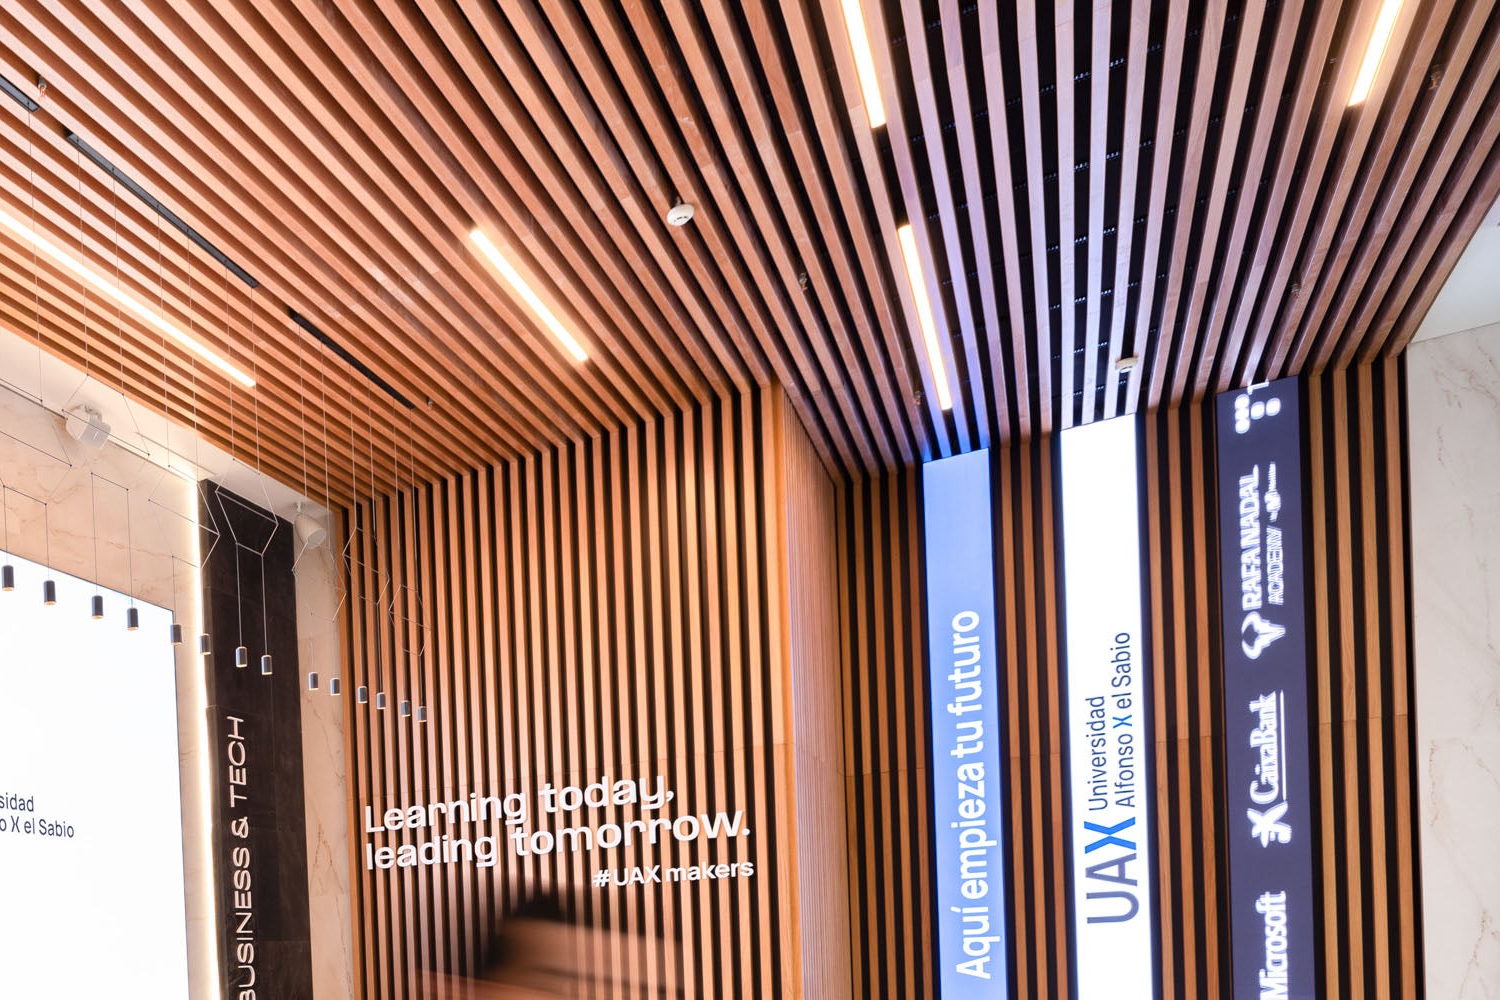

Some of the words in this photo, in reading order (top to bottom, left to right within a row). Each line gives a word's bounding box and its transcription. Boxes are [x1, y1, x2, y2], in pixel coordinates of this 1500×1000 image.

[1265, 524, 1285, 606] ACADEMY
[947, 610, 983, 716] futuro
[1109, 632, 1132, 688] Sabio
[1111, 692, 1132, 710] el
[1112, 713, 1133, 729] X
[226, 716, 248, 808] TECH
[950, 720, 985, 760] tu
[1085, 695, 1109, 811] Universidad
[1114, 733, 1136, 808] Alfonso
[1249, 690, 1278, 805] CaixaBank
[10, 815, 21, 833] X
[23, 817, 36, 835] el
[38, 818, 75, 839] Sabio
[231, 816, 249, 839] &
[364, 792, 528, 834] Learning
[538, 775, 675, 814] today,
[951, 761, 998, 900] empieza
[366, 832, 498, 871] leading
[510, 809, 751, 857] tomorrow.
[592, 864, 662, 888] #UAX
[666, 859, 755, 884] makers
[1083, 816, 1140, 925] UAX
[951, 905, 1001, 980] Aquí
